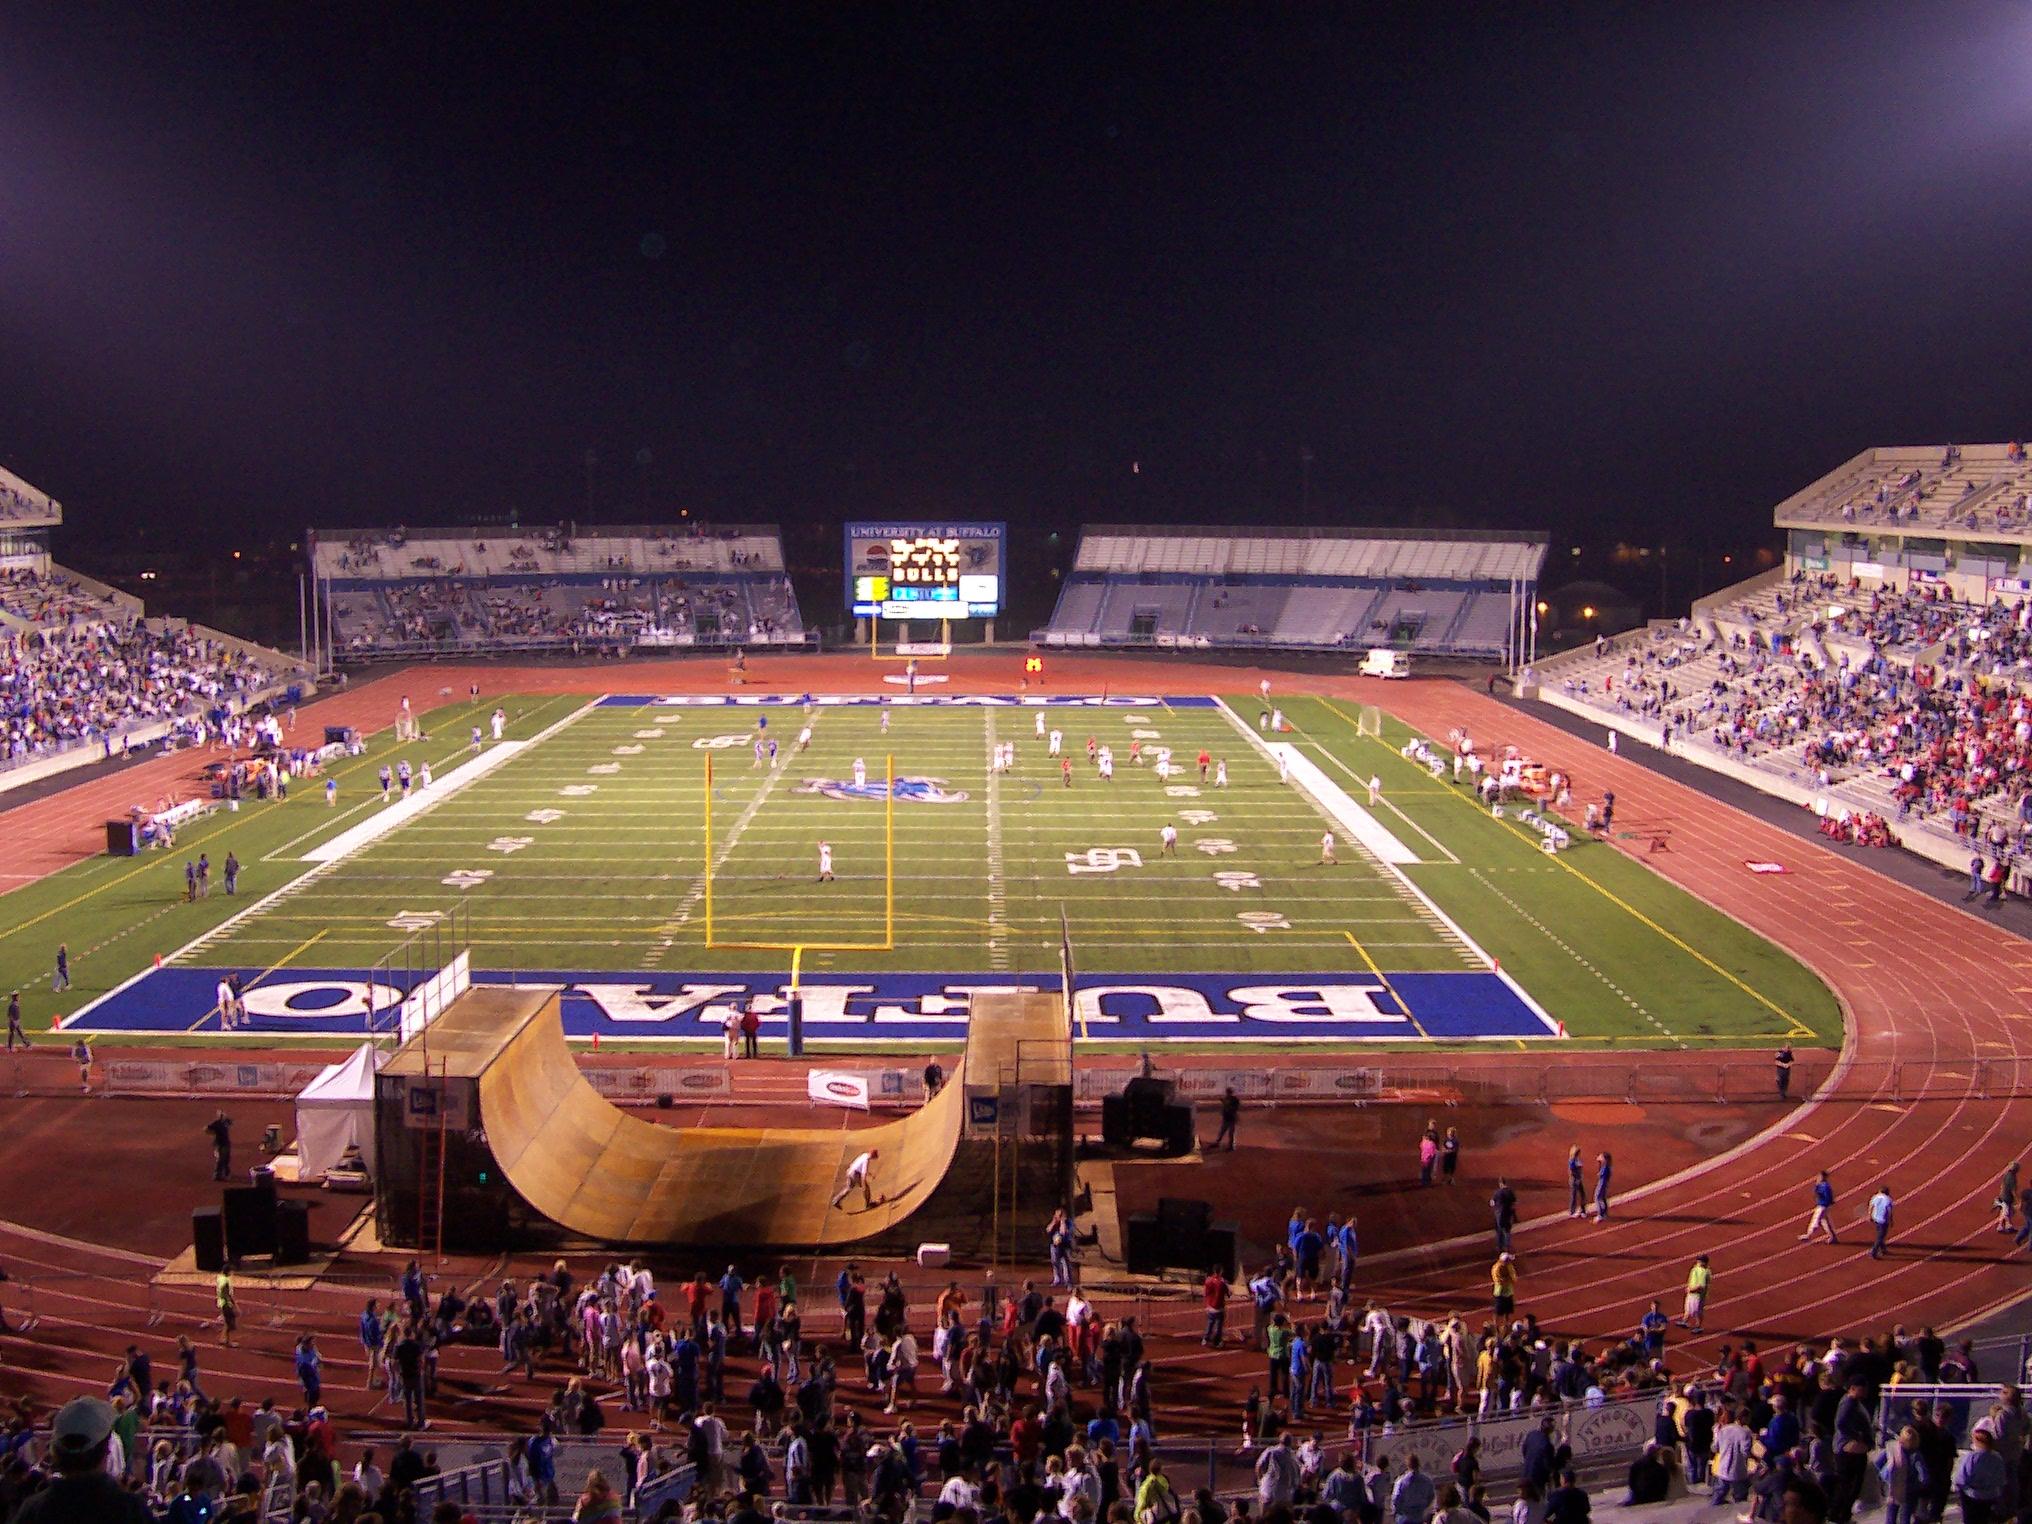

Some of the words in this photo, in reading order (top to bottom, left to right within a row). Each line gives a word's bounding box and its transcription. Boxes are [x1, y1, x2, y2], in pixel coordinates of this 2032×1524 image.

[851, 527, 925, 537] UNIVERSITY
[928, 527, 942, 537] AT
[946, 527, 999, 537] BUFFALO
[893, 567, 959, 582] BULLS
[241, 979, 1407, 1023] BUFFAO
